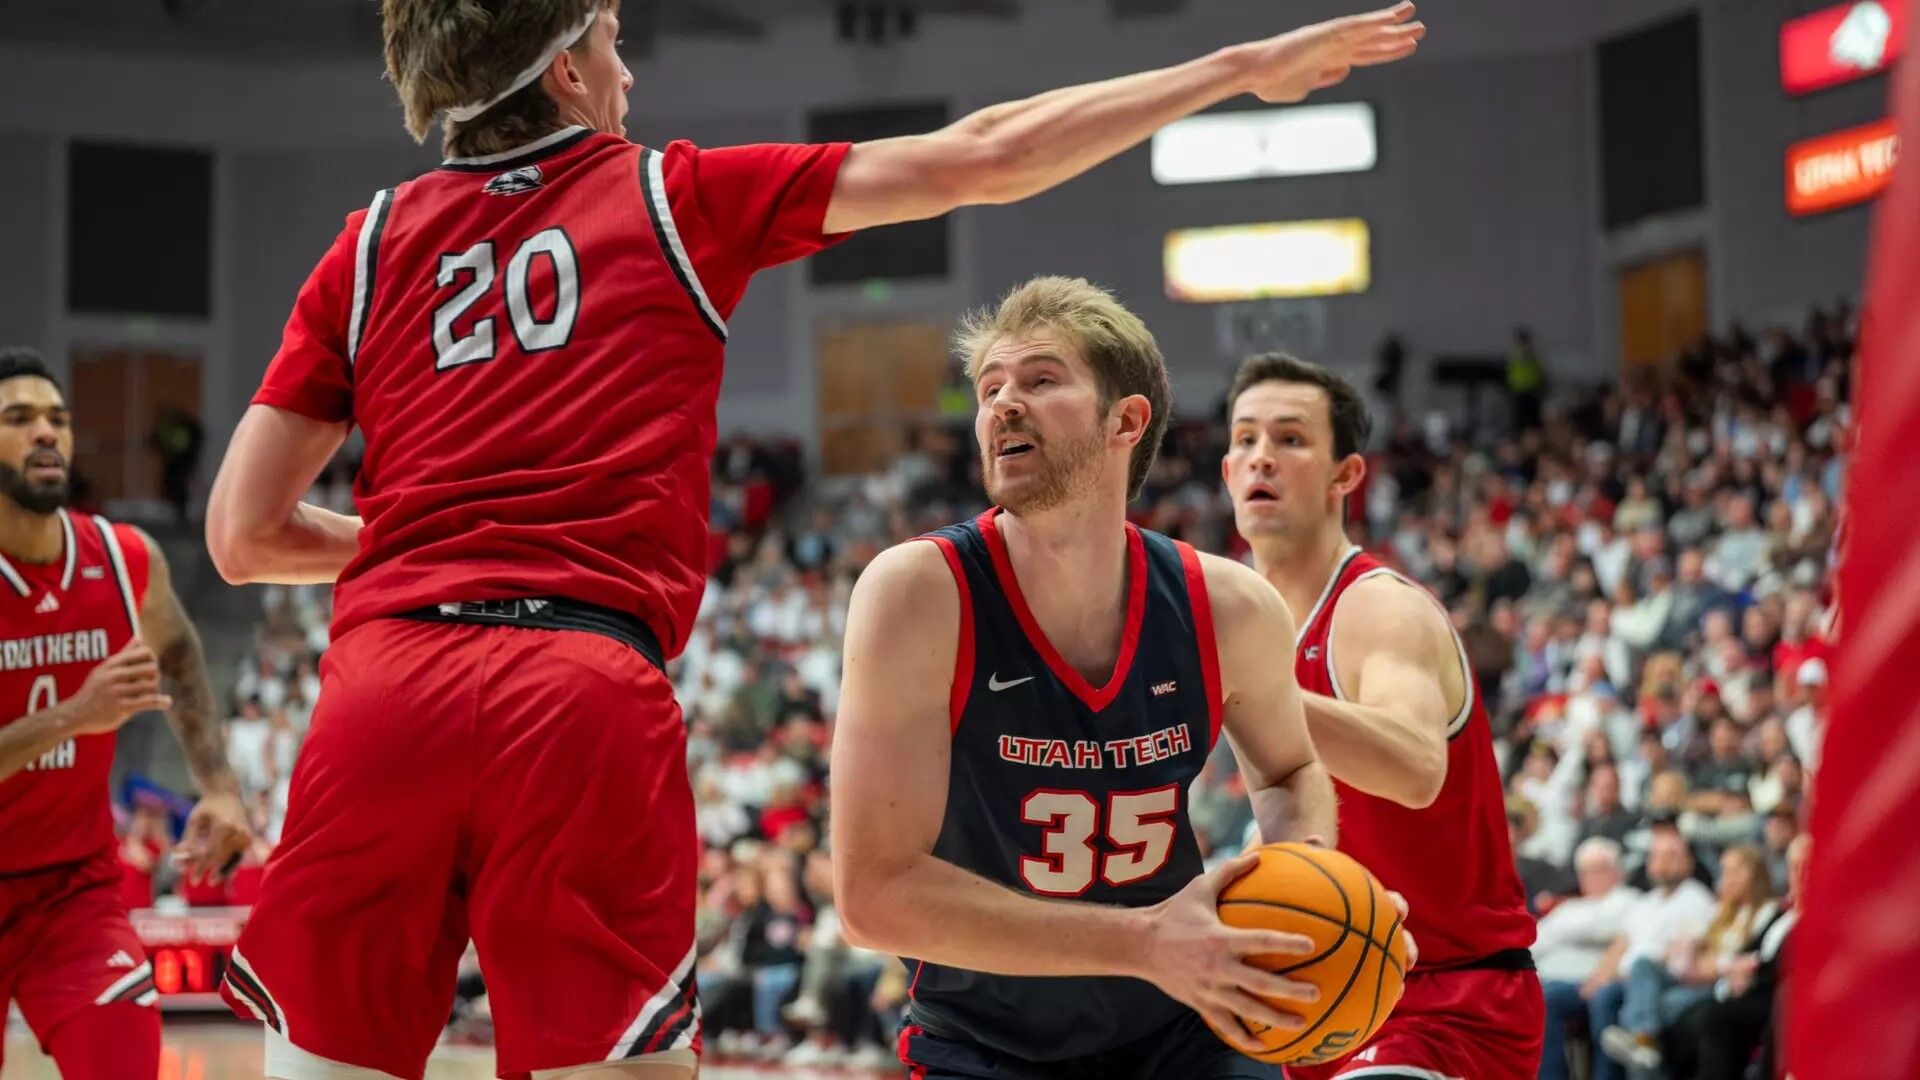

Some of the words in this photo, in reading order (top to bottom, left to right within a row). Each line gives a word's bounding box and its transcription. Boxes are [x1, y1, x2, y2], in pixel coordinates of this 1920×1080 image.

[432, 226, 581, 372] 20
[0, 628, 109, 670] OUTHERN
[1151, 680, 1177, 696] WAC
[999, 735, 1103, 769] UTAH
[1105, 722, 1192, 768] TECH
[1019, 782, 1180, 898] 35
